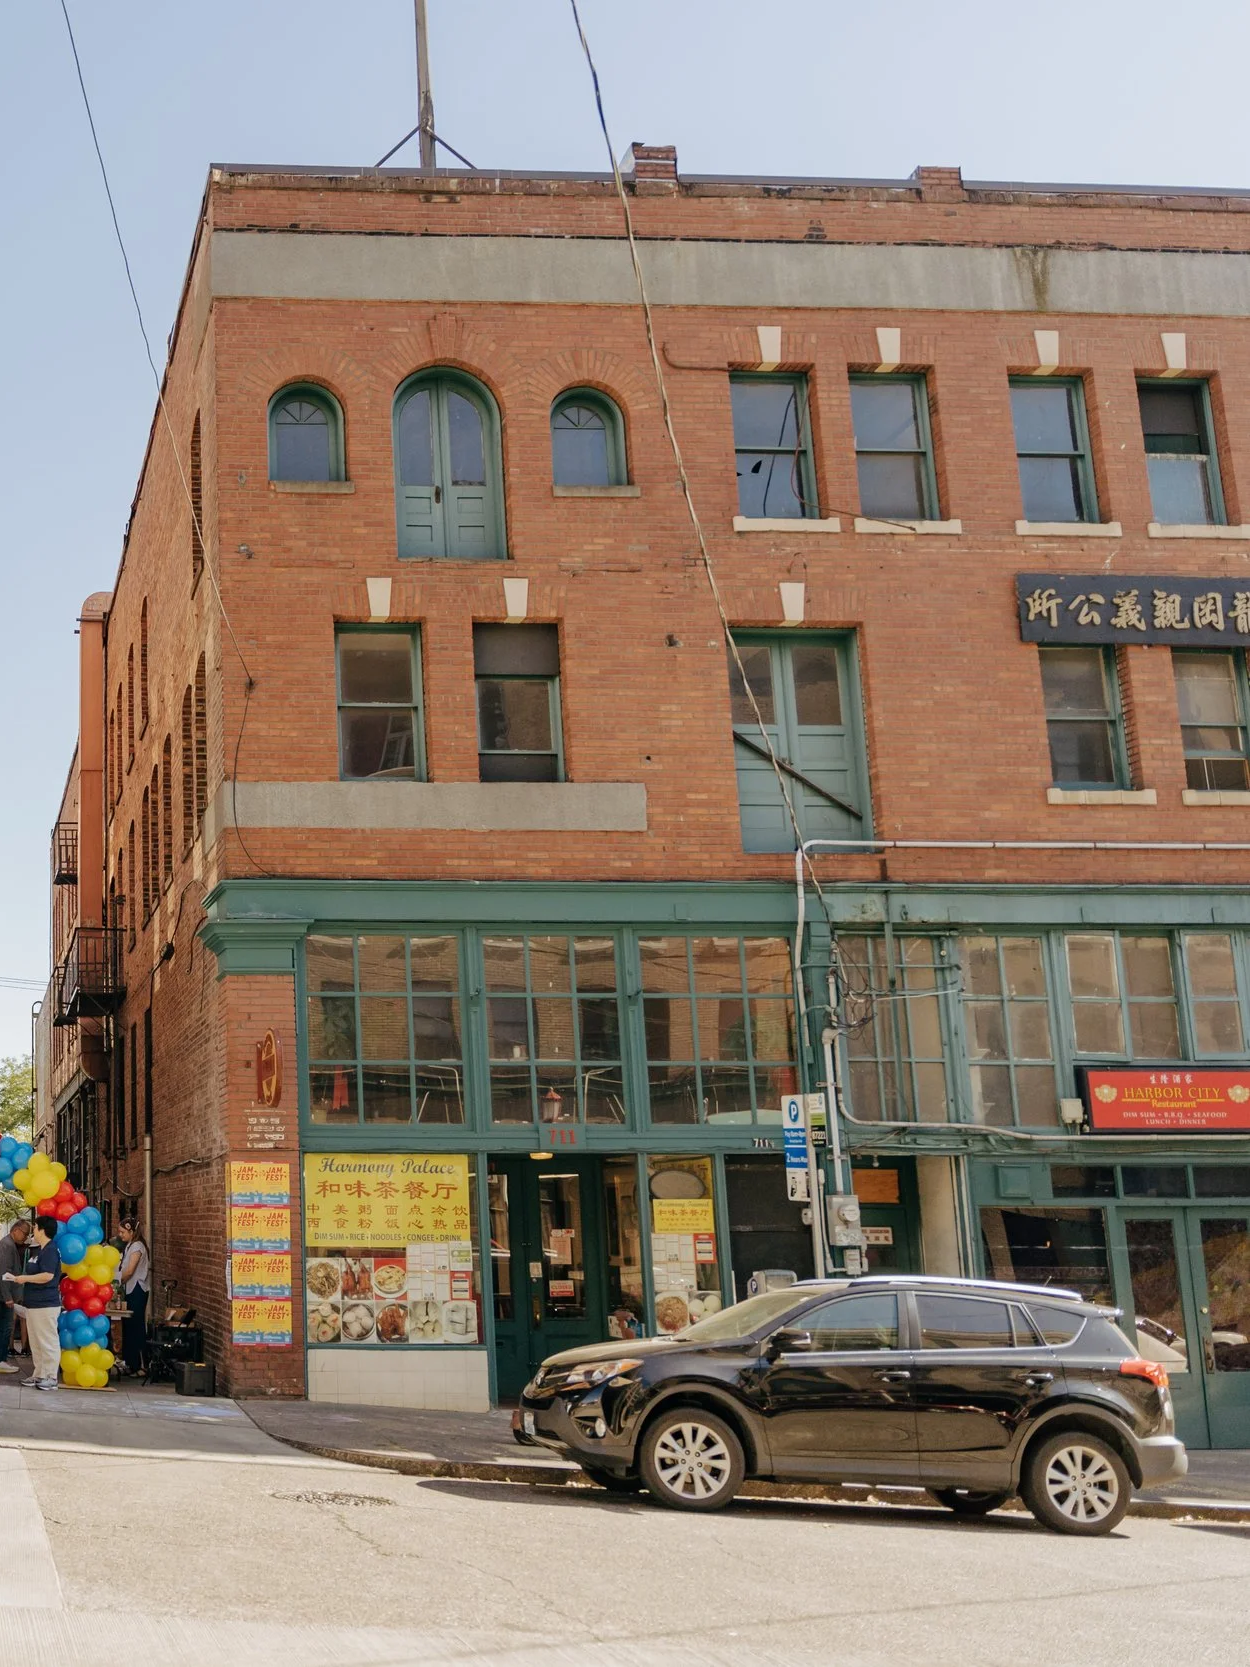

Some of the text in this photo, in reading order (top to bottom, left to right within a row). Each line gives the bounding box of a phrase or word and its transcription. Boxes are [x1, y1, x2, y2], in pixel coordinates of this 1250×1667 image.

[1124, 1087, 1221, 1099] HARBOR CITY
[1151, 1100, 1197, 1108] Restaurant
[790, 1104, 797, 1119] P
[548, 1129, 577, 1145] 711
[786, 1152, 791, 1163] 2
[318, 1157, 455, 1178] Harmony Palace
[315, 1180, 459, 1200] 和味茶餐厅
[314, 1232, 328, 1241] DIM
[328, 1233, 345, 1241] SUM
[350, 1233, 365, 1241] RICE
[370, 1233, 402, 1241] NOODLES
[407, 1233, 435, 1241] CONGEE
